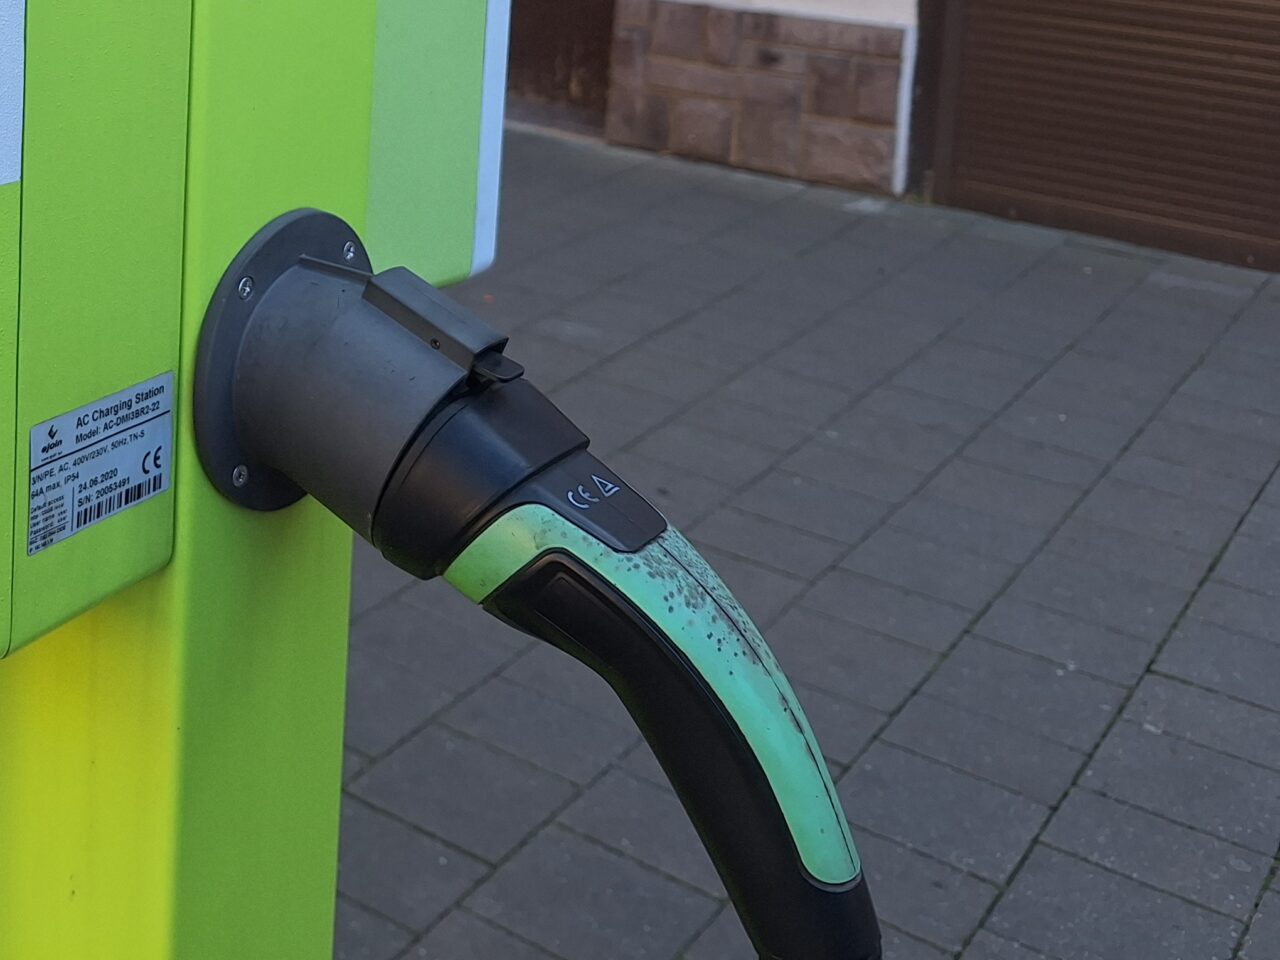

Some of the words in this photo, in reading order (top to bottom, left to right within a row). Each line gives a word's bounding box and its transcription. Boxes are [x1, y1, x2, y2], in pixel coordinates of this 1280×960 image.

[76, 413, 90, 429] AC
[91, 398, 133, 422] Charging
[135, 385, 165, 404] Station
[75, 427, 101, 444] Model:
[41, 439, 63, 454] ejoin
[64, 471, 80, 485] IP54
[78, 467, 119, 493] 24.06.2020
[77, 494, 94, 508] S/N:
